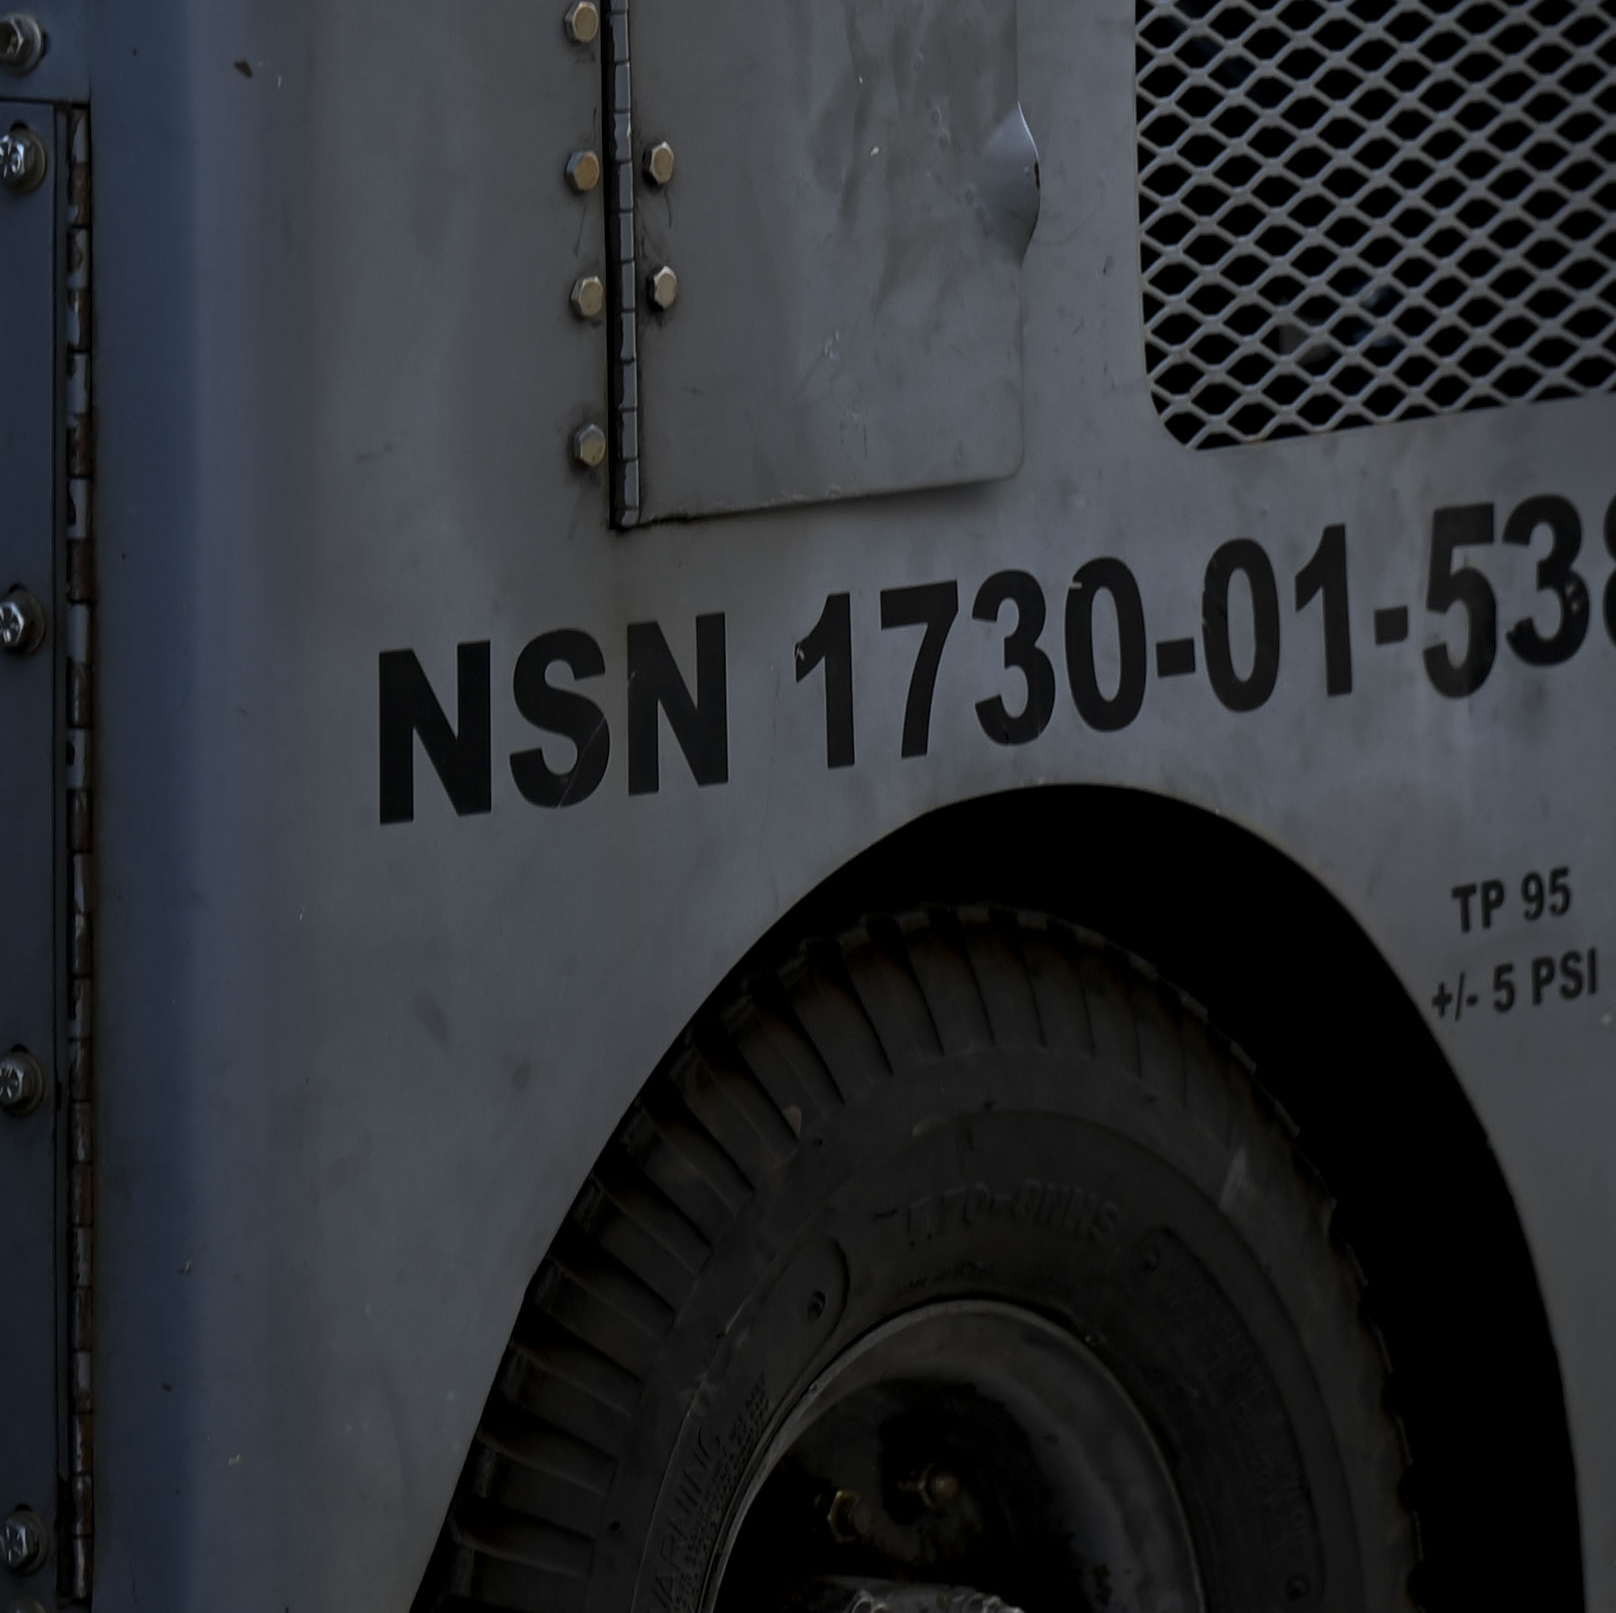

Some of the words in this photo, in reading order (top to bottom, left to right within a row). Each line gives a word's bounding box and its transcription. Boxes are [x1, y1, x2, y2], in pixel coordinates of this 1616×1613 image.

[379, 611, 729, 824] NSN
[1451, 880, 1505, 933] TP
[1521, 866, 1571, 921] 95
[1432, 971, 1479, 1022] +/-
[1493, 961, 1515, 1014] 5
[1532, 947, 1598, 1006] PSI
